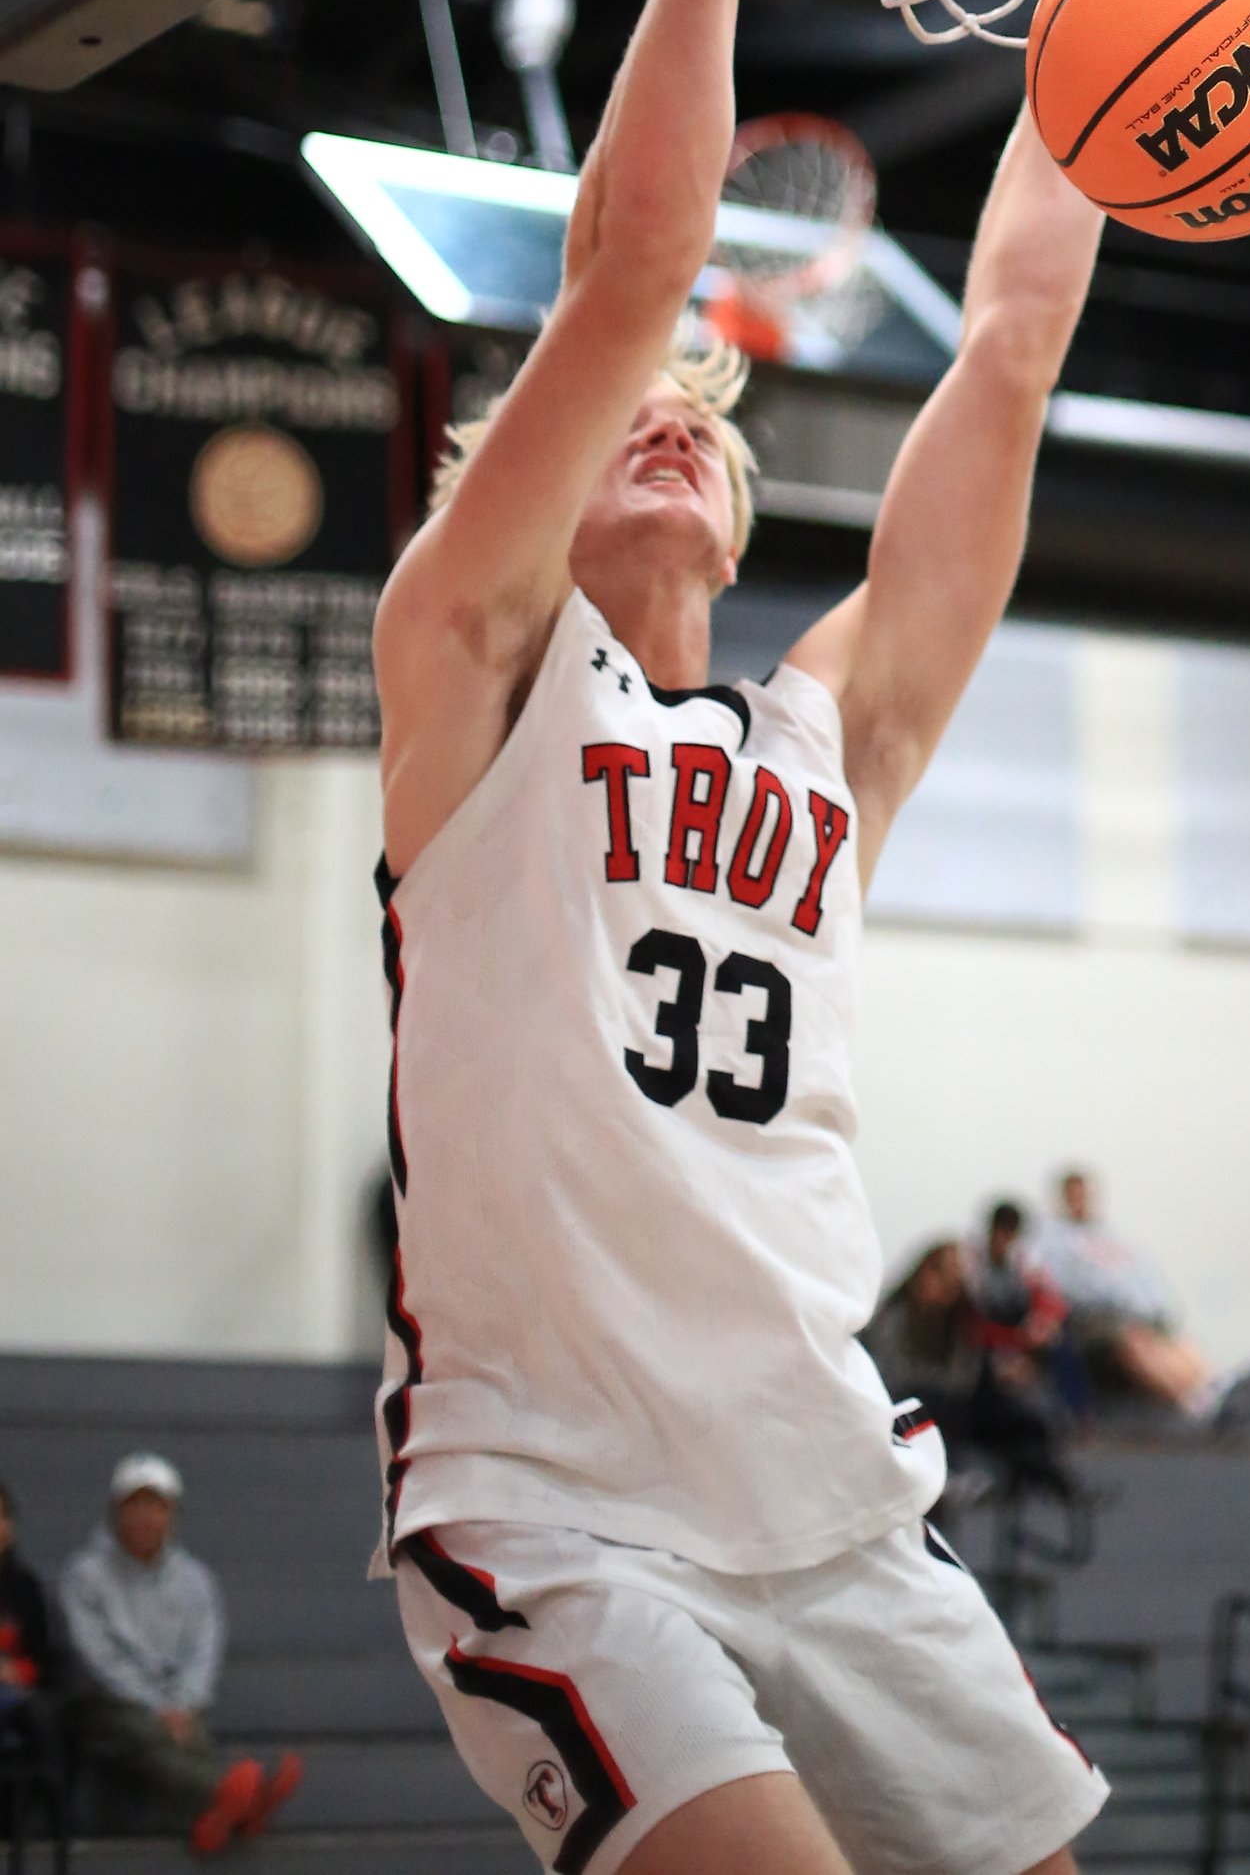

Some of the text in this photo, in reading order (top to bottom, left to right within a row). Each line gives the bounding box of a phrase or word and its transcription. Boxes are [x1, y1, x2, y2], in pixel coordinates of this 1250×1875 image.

[1161, 67, 1202, 105] GAME
[1125, 103, 1162, 130] BALL
[1219, 178, 1246, 194] BALL
[581, 742, 849, 937] TROY
[623, 927, 792, 1126] 33
